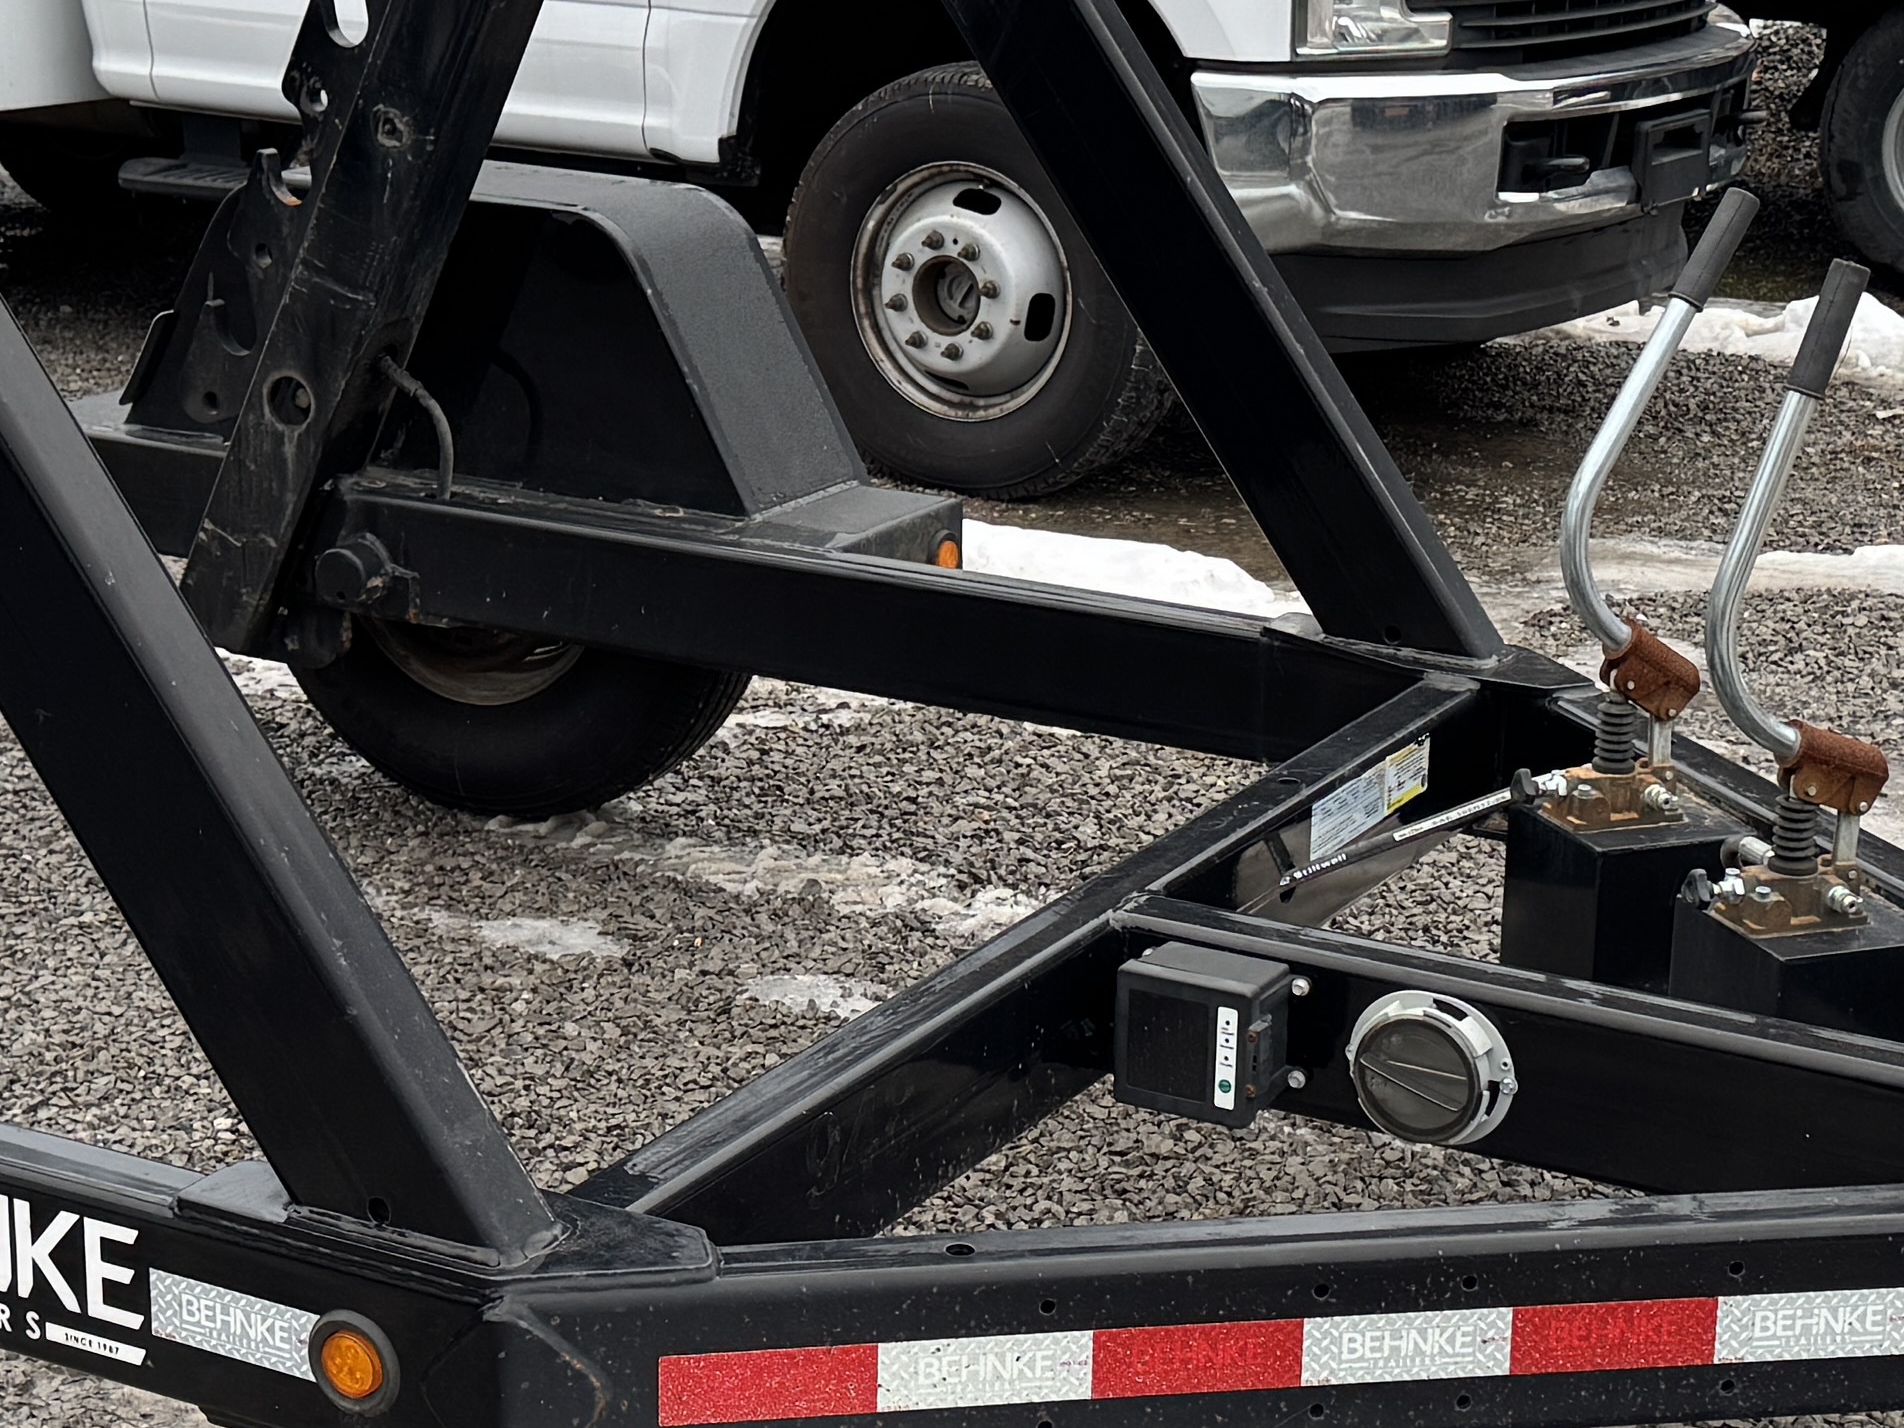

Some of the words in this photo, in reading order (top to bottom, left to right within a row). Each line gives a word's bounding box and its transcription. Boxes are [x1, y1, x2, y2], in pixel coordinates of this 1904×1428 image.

[180, 1293, 292, 1351] BEHNKE
[1753, 1305, 1886, 1338] BEHNKE
[1341, 1325, 1474, 1360] BEHNKE
[917, 1348, 1056, 1387] BEHNKE
